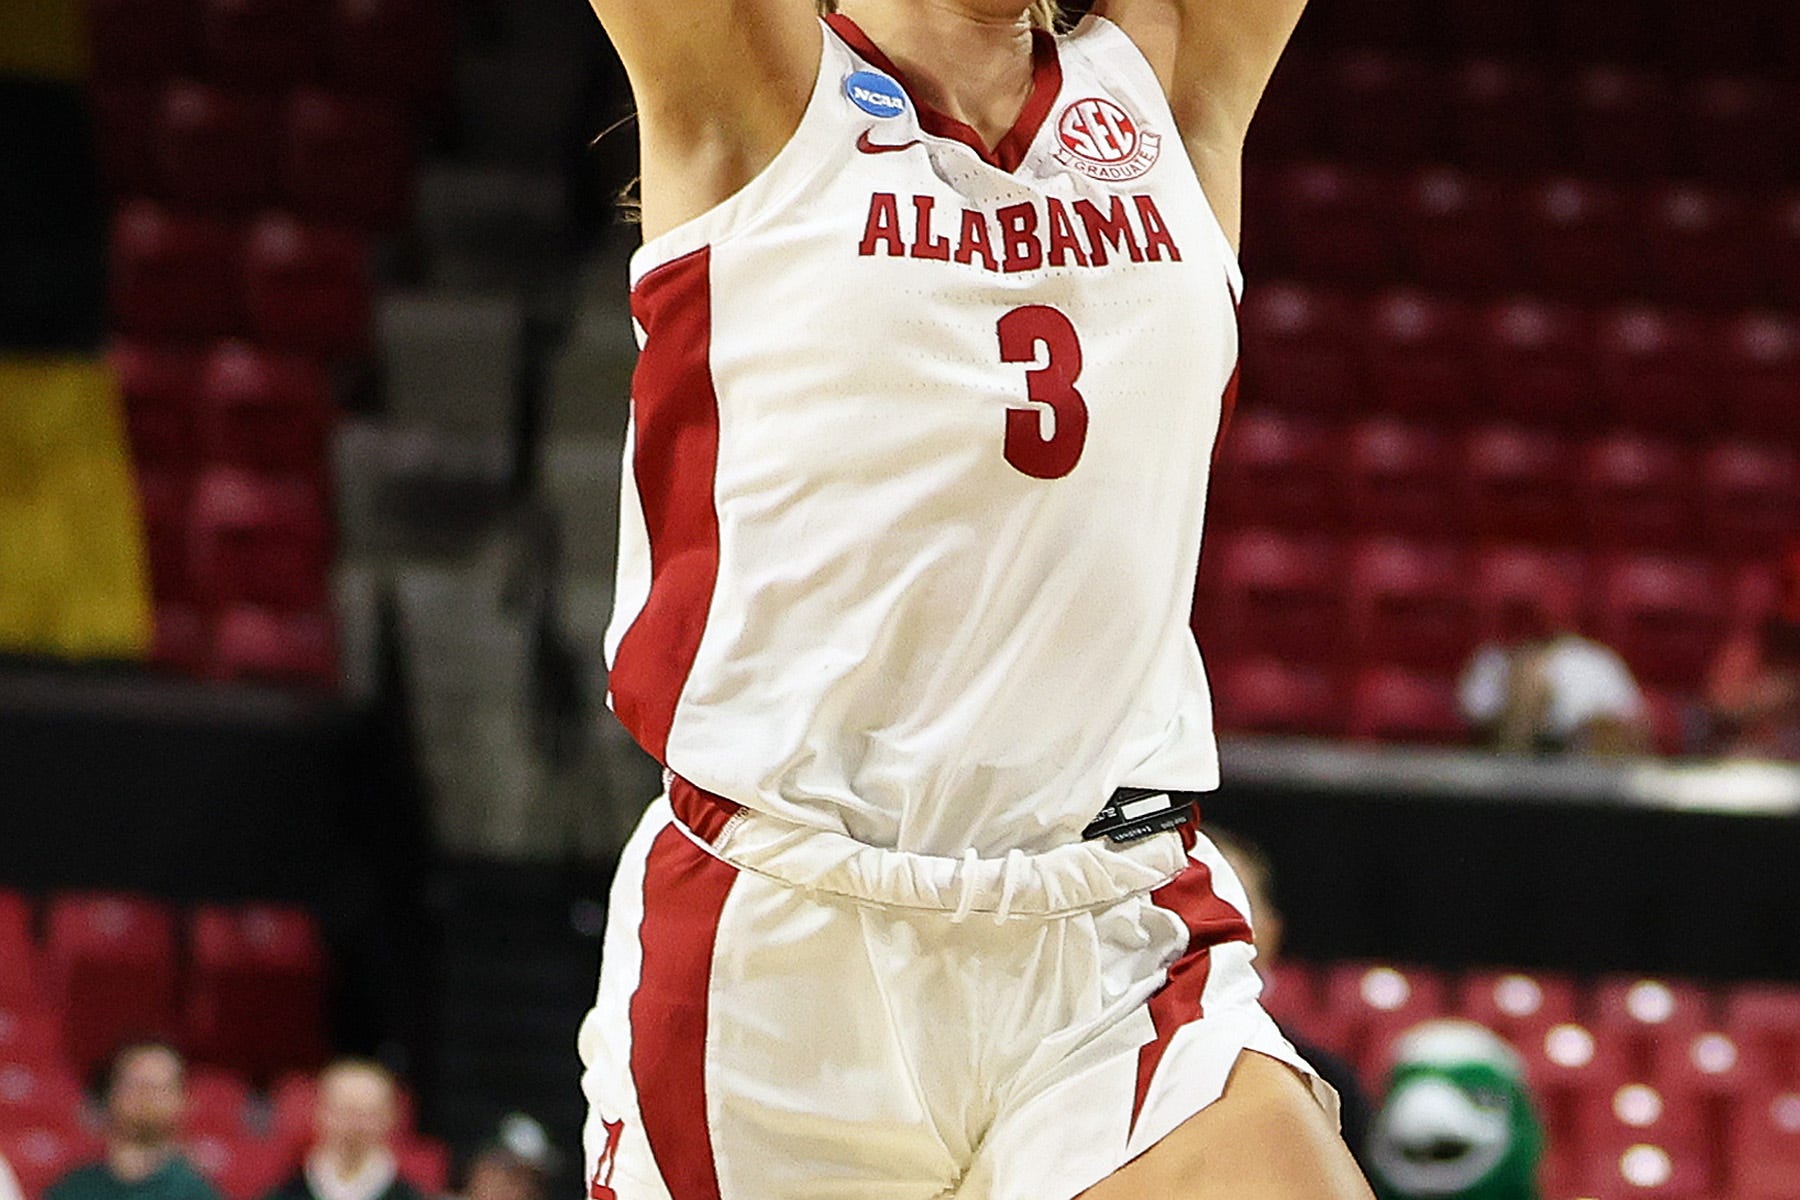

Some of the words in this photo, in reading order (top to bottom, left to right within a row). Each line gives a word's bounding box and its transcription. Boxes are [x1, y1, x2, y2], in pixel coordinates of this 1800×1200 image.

[853, 86, 904, 110] NCAA
[1060, 101, 1134, 160] SEC
[1074, 151, 1154, 178] GRADUATE
[859, 192, 1182, 272] ALABAMA
[996, 304, 1088, 479] 3
